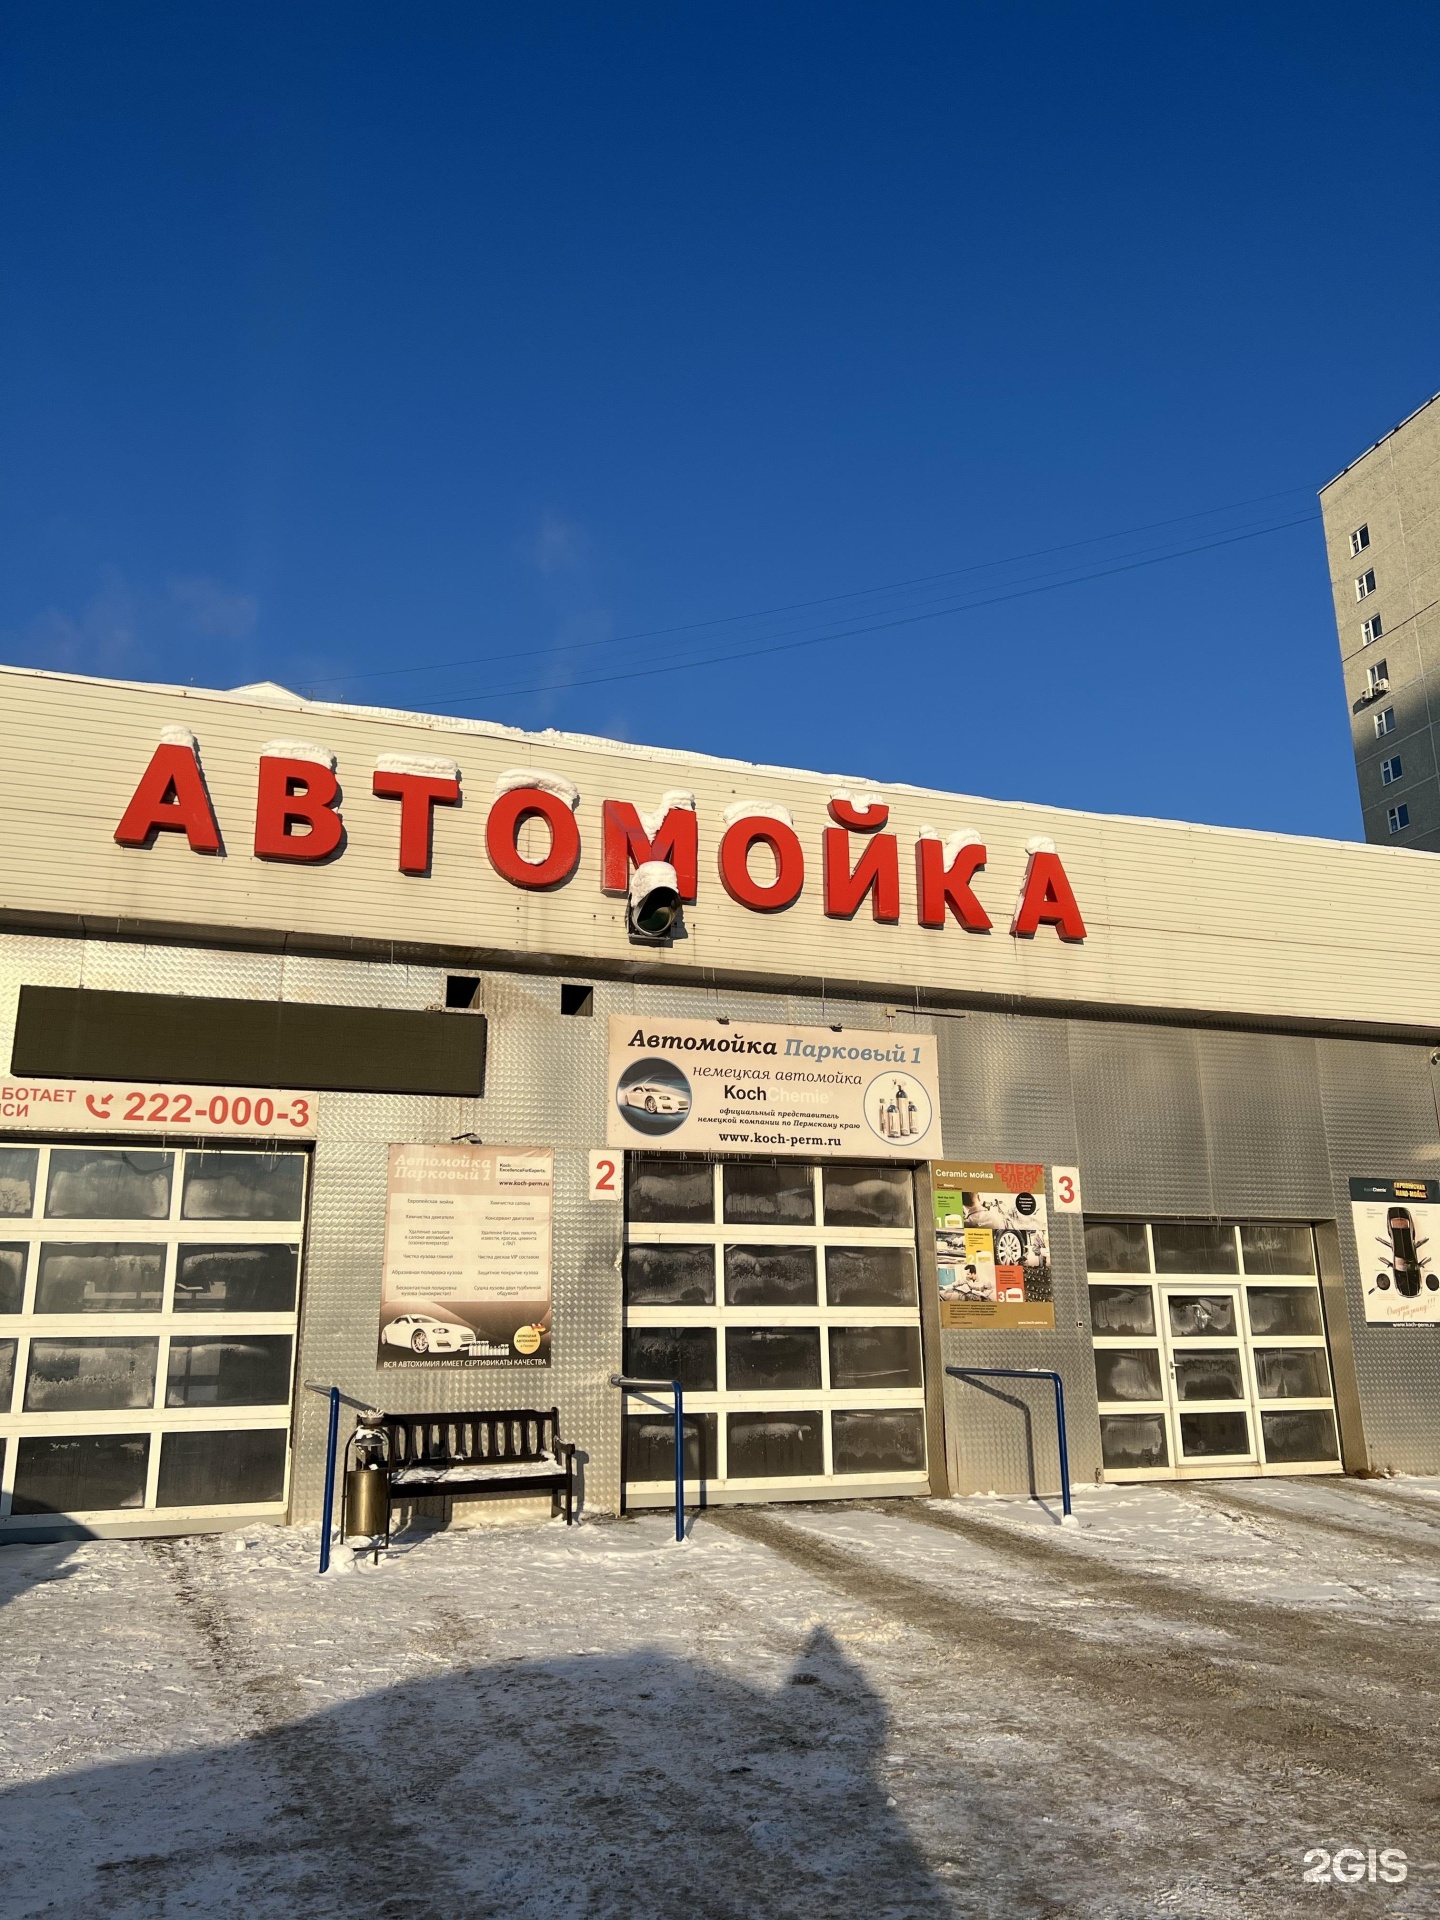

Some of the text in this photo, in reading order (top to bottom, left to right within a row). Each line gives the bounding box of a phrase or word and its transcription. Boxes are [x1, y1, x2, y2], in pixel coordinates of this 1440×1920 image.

[113, 743, 1087, 942] АВТОМОЙКА
[628, 1029, 921, 1063] Автомойка Парковый 1
[693, 1066, 863, 1085] немецкая автомойка
[0, 1103, 29, 1117] СИ
[123, 1091, 310, 1127] 222-000-3
[719, 1107, 840, 1120] официальный представитель
[697, 1116, 861, 1130] немецкой компании по Пермскому краю
[718, 1131, 842, 1147] www.koch-perm.ru
[394, 1153, 492, 1169] Автомойка
[994, 1162, 1044, 1175] БЛЕСК
[394, 1165, 491, 1182] Парковый 1
[595, 1160, 615, 1190] 2
[935, 1168, 994, 1179] Ceramic мойка
[1001, 1173, 1039, 1184] БЛЕСК
[1058, 1175, 1075, 1204] 3
[997, 1292, 1006, 1303] 3
[398, 1360, 440, 1368] АВТОХИМИЯ
[464, 1358, 513, 1367] СЕРТИФИКАТЫ
[514, 1358, 547, 1366] КАЧЕСТВА
